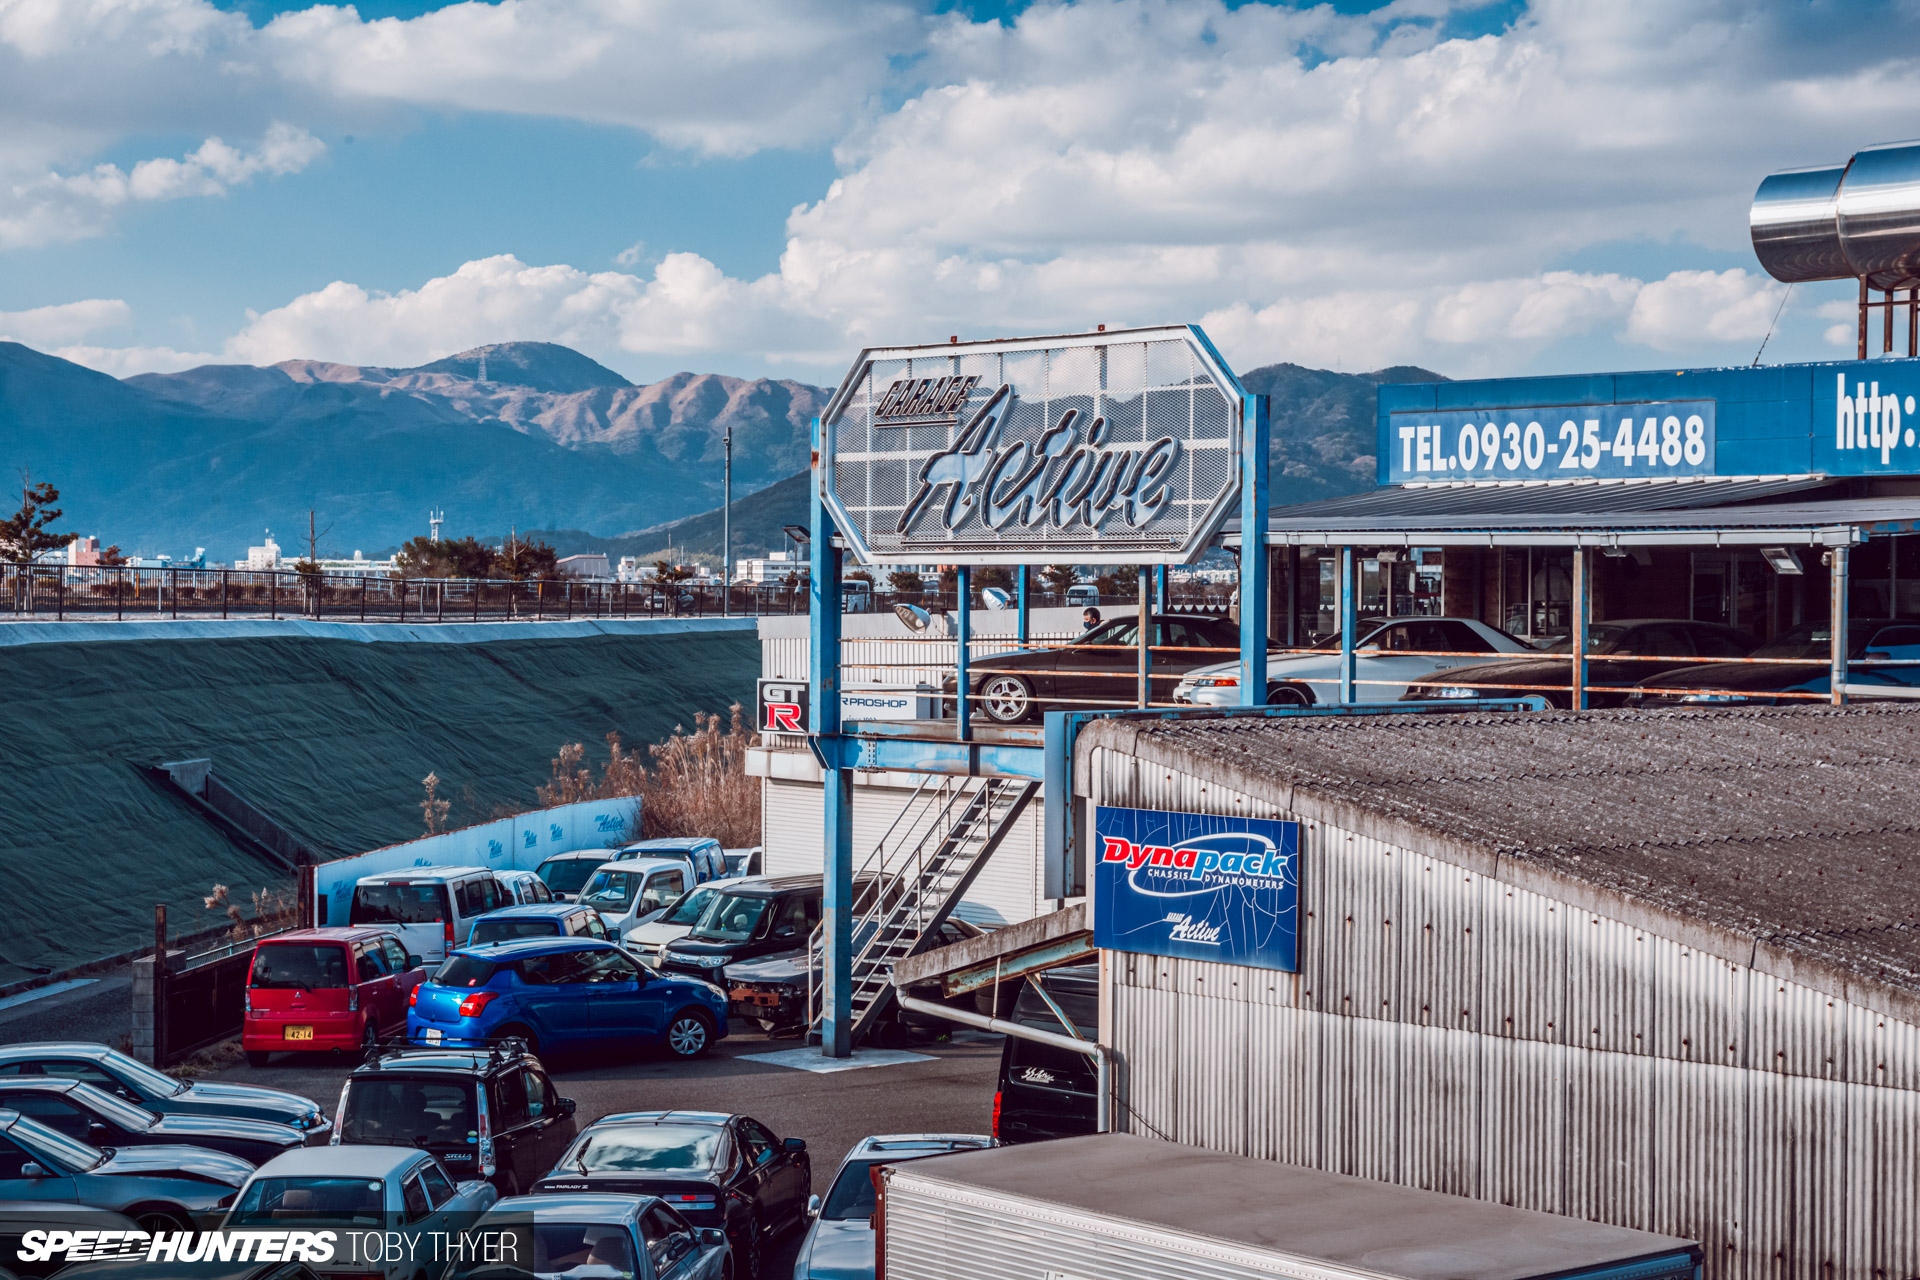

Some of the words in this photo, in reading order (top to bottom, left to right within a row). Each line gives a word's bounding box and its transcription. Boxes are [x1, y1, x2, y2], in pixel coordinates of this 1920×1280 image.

[874, 375, 982, 416] GARAGE
[896, 383, 1178, 534] Active
[763, 683, 805, 703] GT
[850, 698, 908, 708] PROSHOP
[763, 702, 804, 731] R
[1103, 836, 1288, 881] Dynapack
[1148, 869, 1189, 880] CHASSIS
[1205, 874, 1285, 889] DYNAMOMETERS
[1169, 915, 1220, 940] Active
[291, 1031, 312, 1039] 42-14
